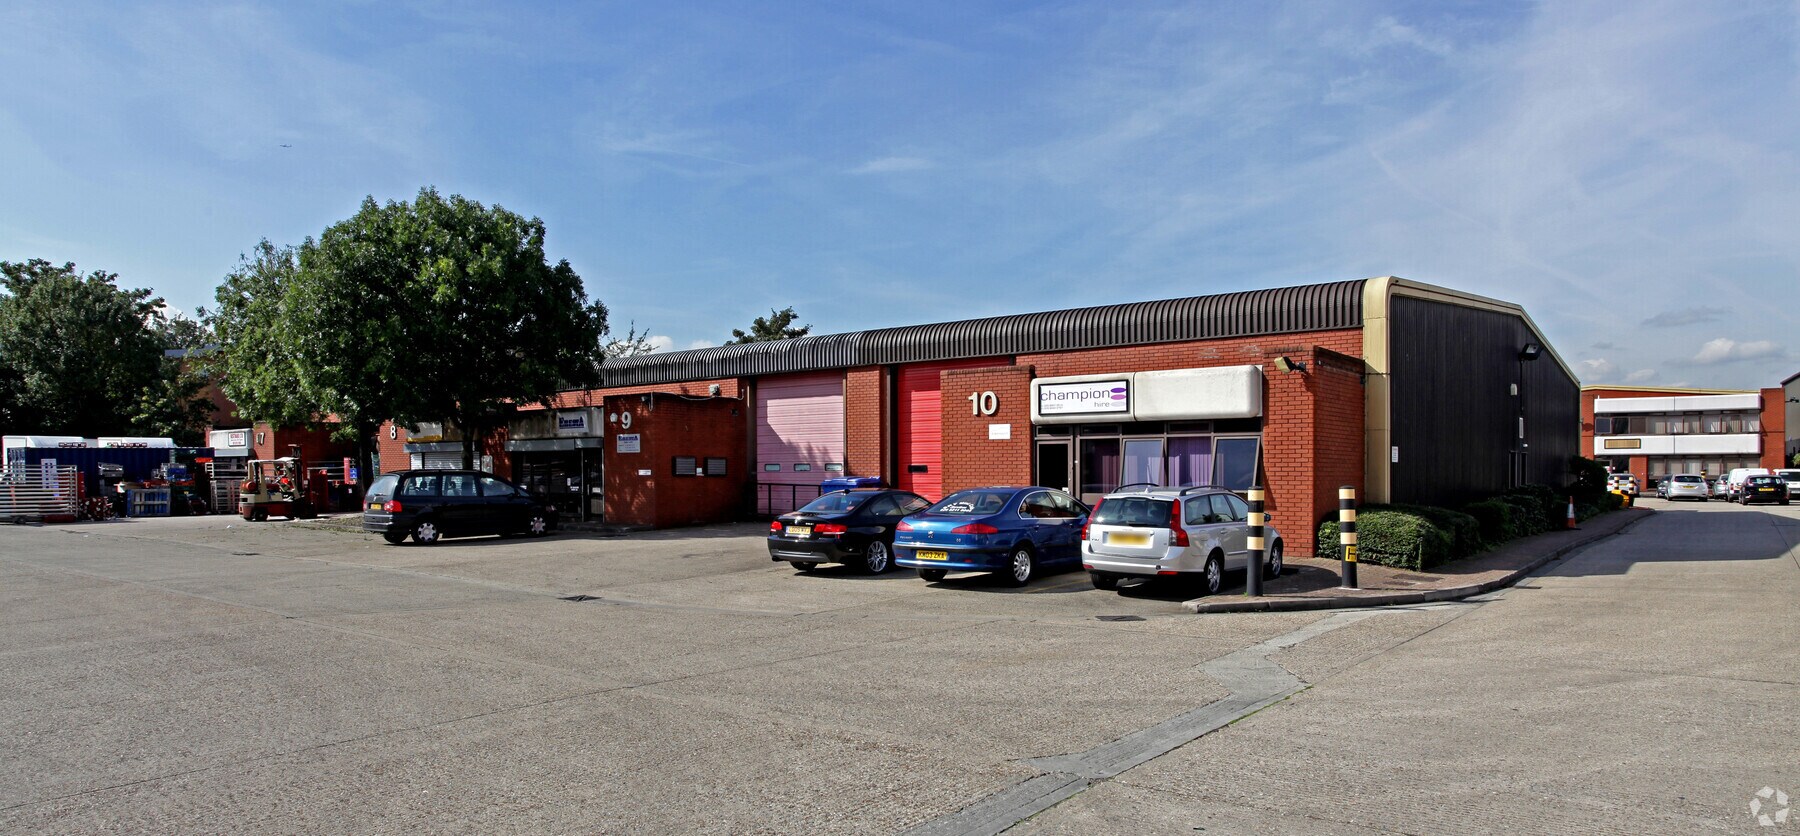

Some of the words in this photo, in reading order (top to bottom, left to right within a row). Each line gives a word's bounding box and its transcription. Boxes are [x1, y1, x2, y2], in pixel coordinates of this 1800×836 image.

[968, 390, 997, 415] 10
[1040, 388, 1110, 402] champion
[621, 411, 632, 429] 9
[390, 425, 396, 440] 8
